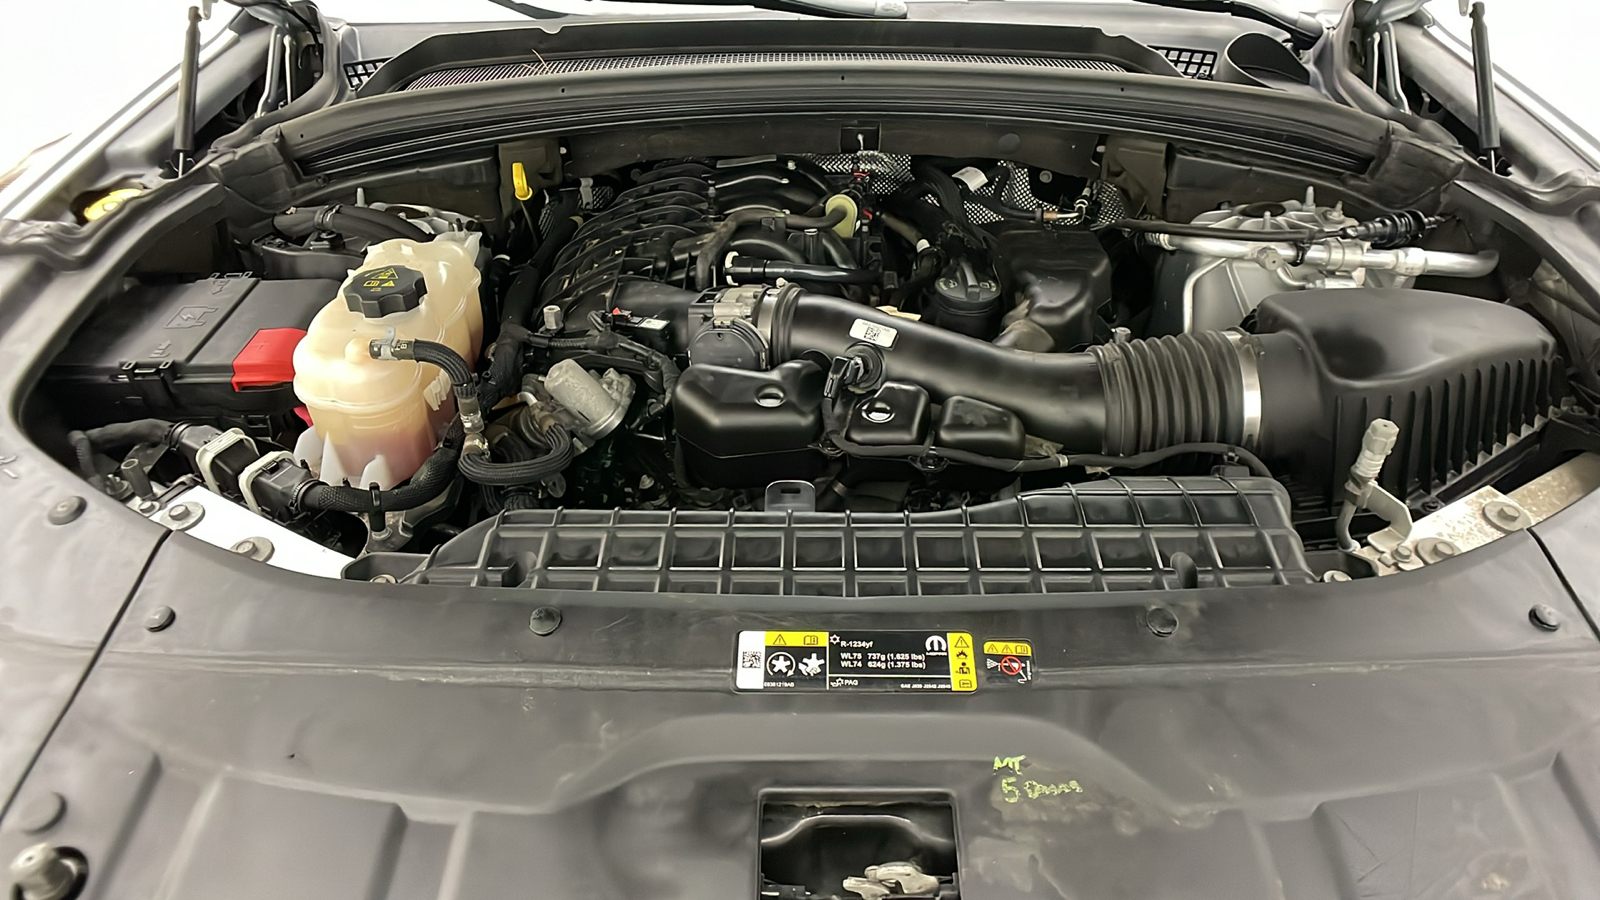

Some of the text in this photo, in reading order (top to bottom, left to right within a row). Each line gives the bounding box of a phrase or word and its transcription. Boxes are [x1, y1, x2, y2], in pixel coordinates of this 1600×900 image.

[840, 640, 873, 649] R-1234yf
[867, 653, 886, 661] 737g
[887, 653, 910, 661] (1.625
[911, 653, 926, 662] lbs)
[867, 661, 886, 670] 624g
[887, 661, 910, 670] (1.375
[911, 661, 926, 670] lbs)
[1001, 776, 1021, 804] 5
